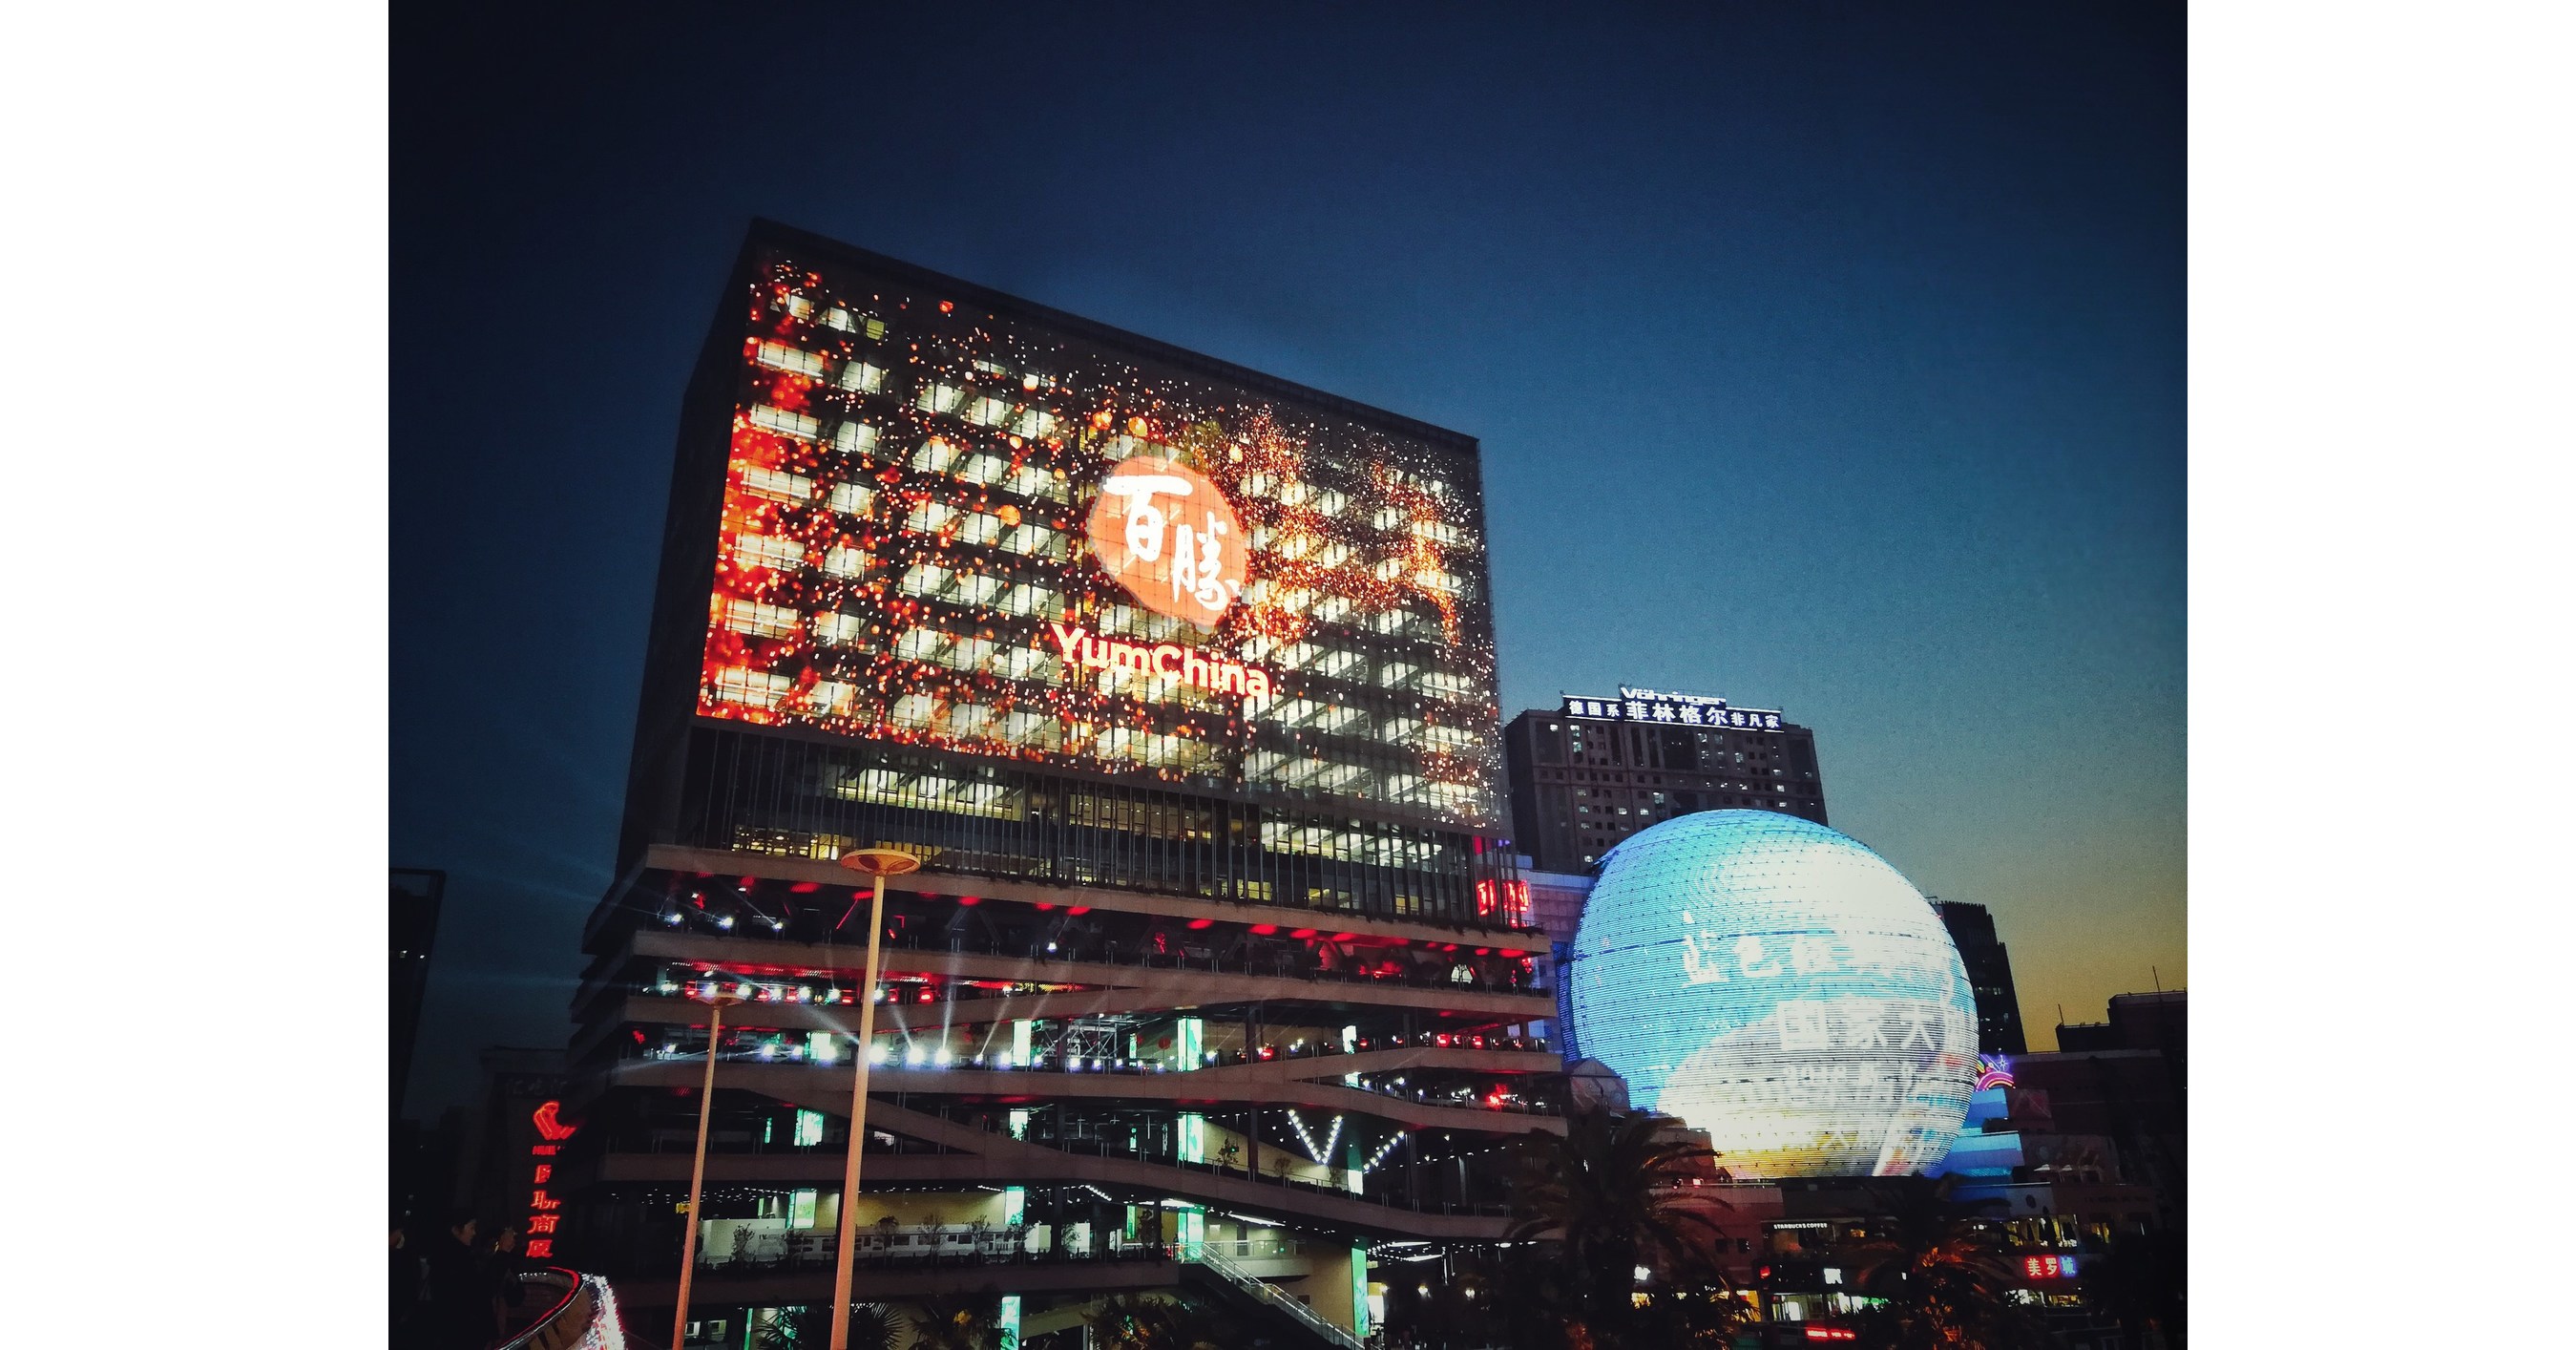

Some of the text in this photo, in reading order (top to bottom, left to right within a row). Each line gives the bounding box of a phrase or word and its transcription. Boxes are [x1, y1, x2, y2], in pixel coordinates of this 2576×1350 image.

[1051, 623, 1270, 700] YumChina
[1625, 701, 1728, 726] 菲林格尔
[1730, 711, 1780, 728] 非凡家
[2027, 1256, 2076, 1276] 美罗城
